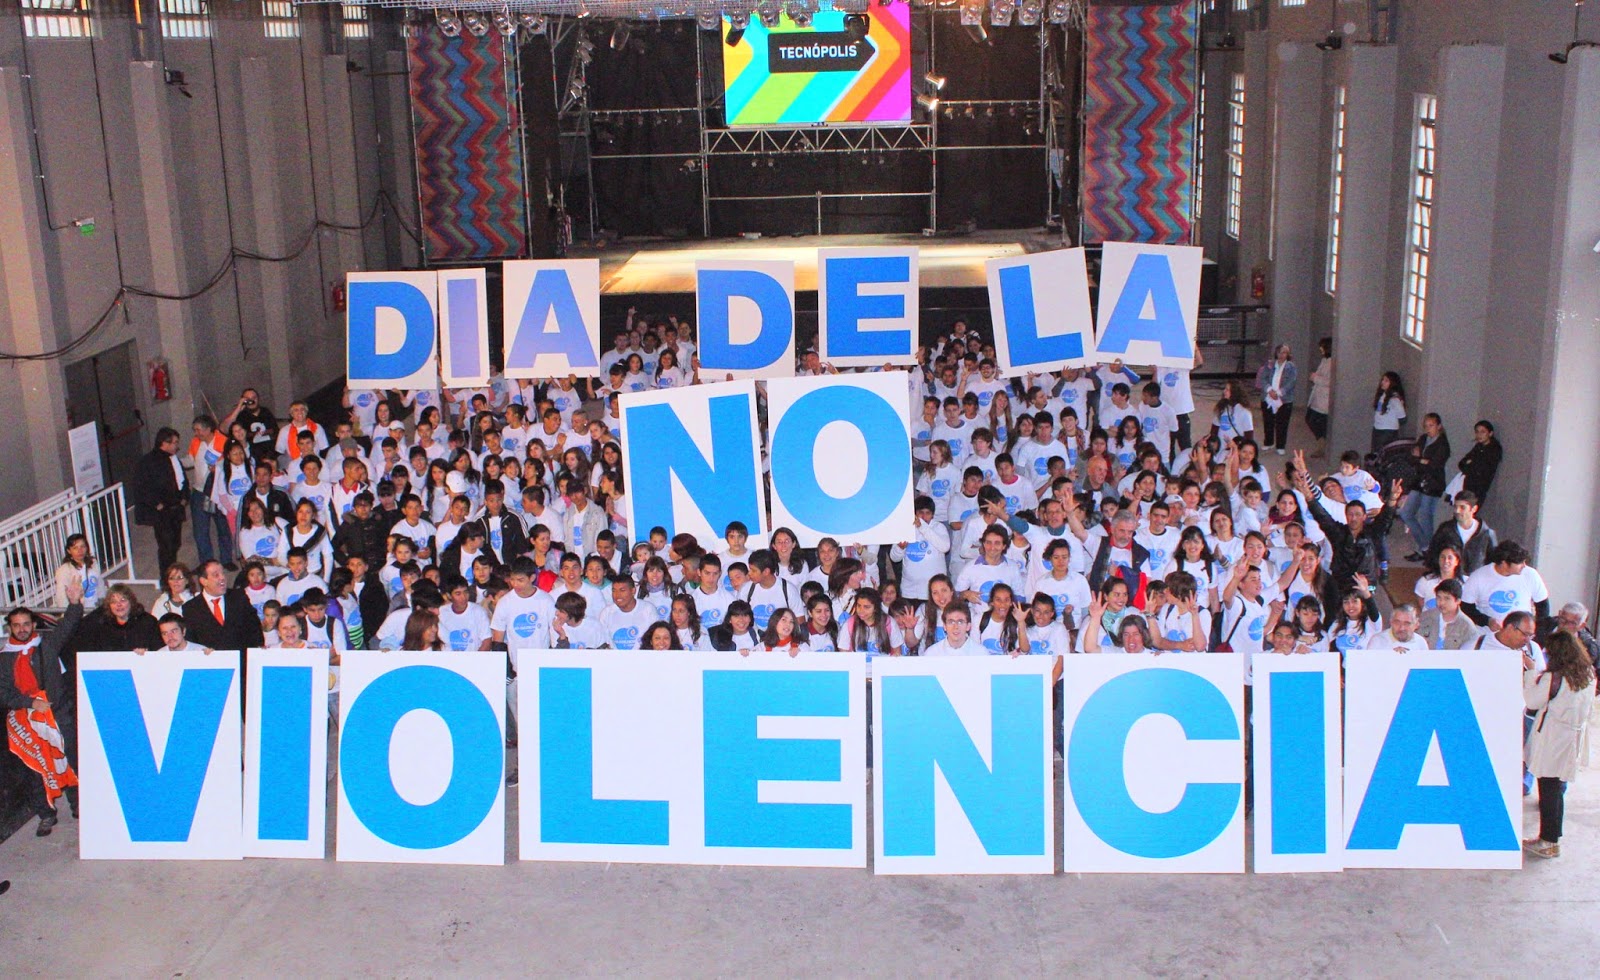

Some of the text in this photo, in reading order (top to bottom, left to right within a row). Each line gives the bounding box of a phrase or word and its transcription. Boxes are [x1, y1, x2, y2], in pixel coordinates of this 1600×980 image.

[779, 43, 857, 59] TECNÓPOLIS
[349, 254, 1193, 380] DIA DE LA
[626, 385, 911, 544] NO
[8, 709, 33, 745] Partido
[80, 665, 1521, 860] VIOLENCIA
